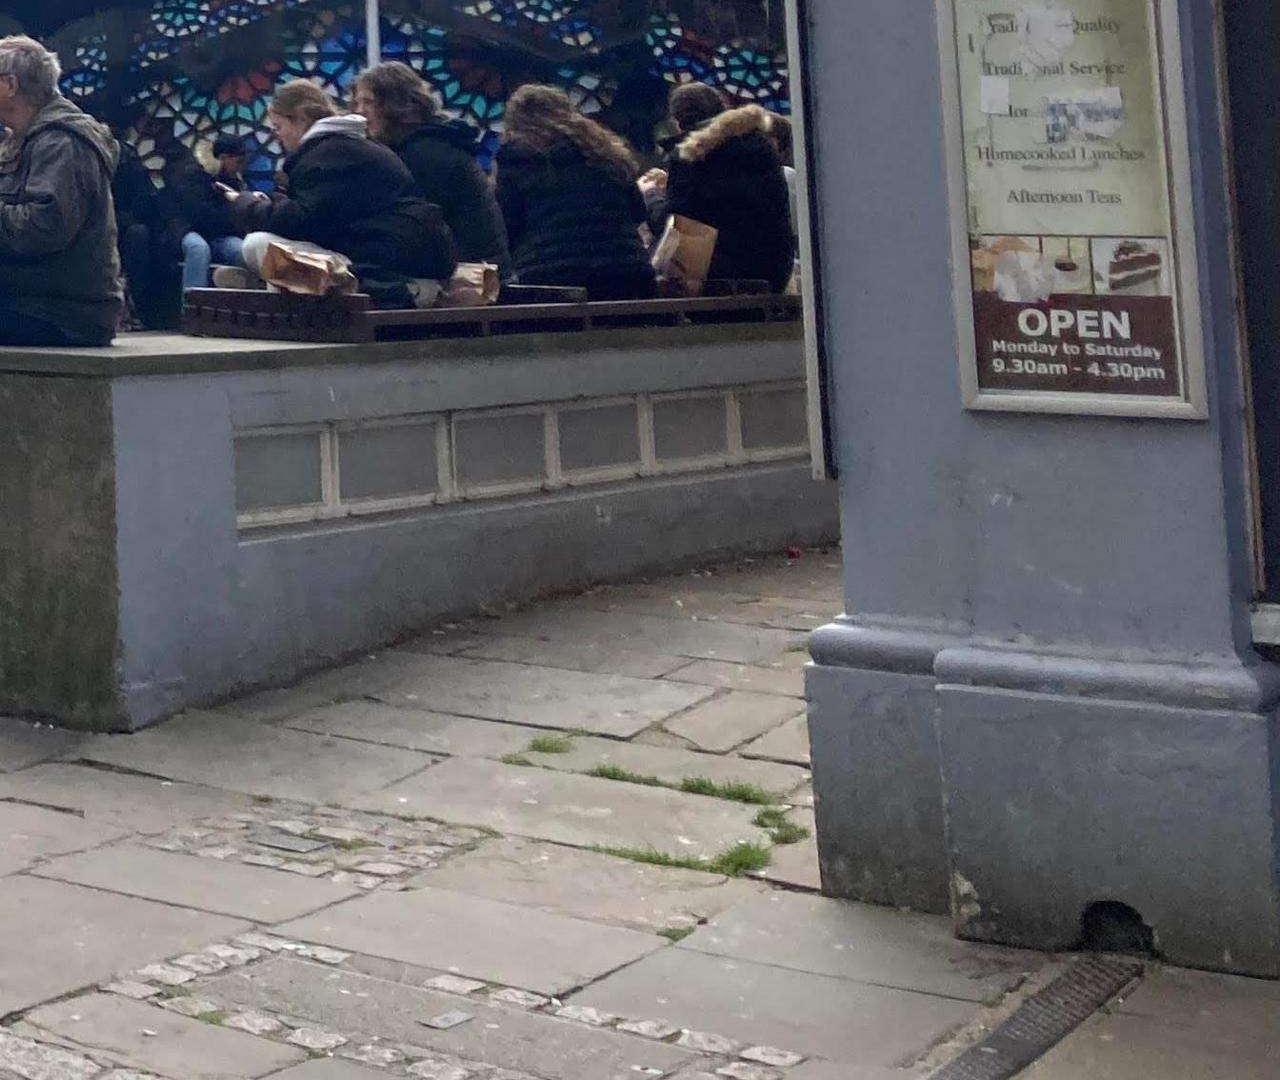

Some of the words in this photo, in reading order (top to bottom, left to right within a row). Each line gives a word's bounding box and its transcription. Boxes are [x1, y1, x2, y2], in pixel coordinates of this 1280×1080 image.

[1069, 61, 1126, 75] Service
[977, 145, 1077, 161] Homecooked
[1081, 146, 1146, 161] Lunches
[1006, 188, 1083, 204] Afternoon
[1086, 189, 1122, 204] Teas
[1017, 307, 1132, 340] OPEN
[992, 339, 1058, 356] Monday
[1062, 341, 1081, 356] to
[1085, 342, 1163, 361] Saturday
[992, 357, 1069, 376] 9.30am
[1086, 361, 1166, 382] 4.30pm
